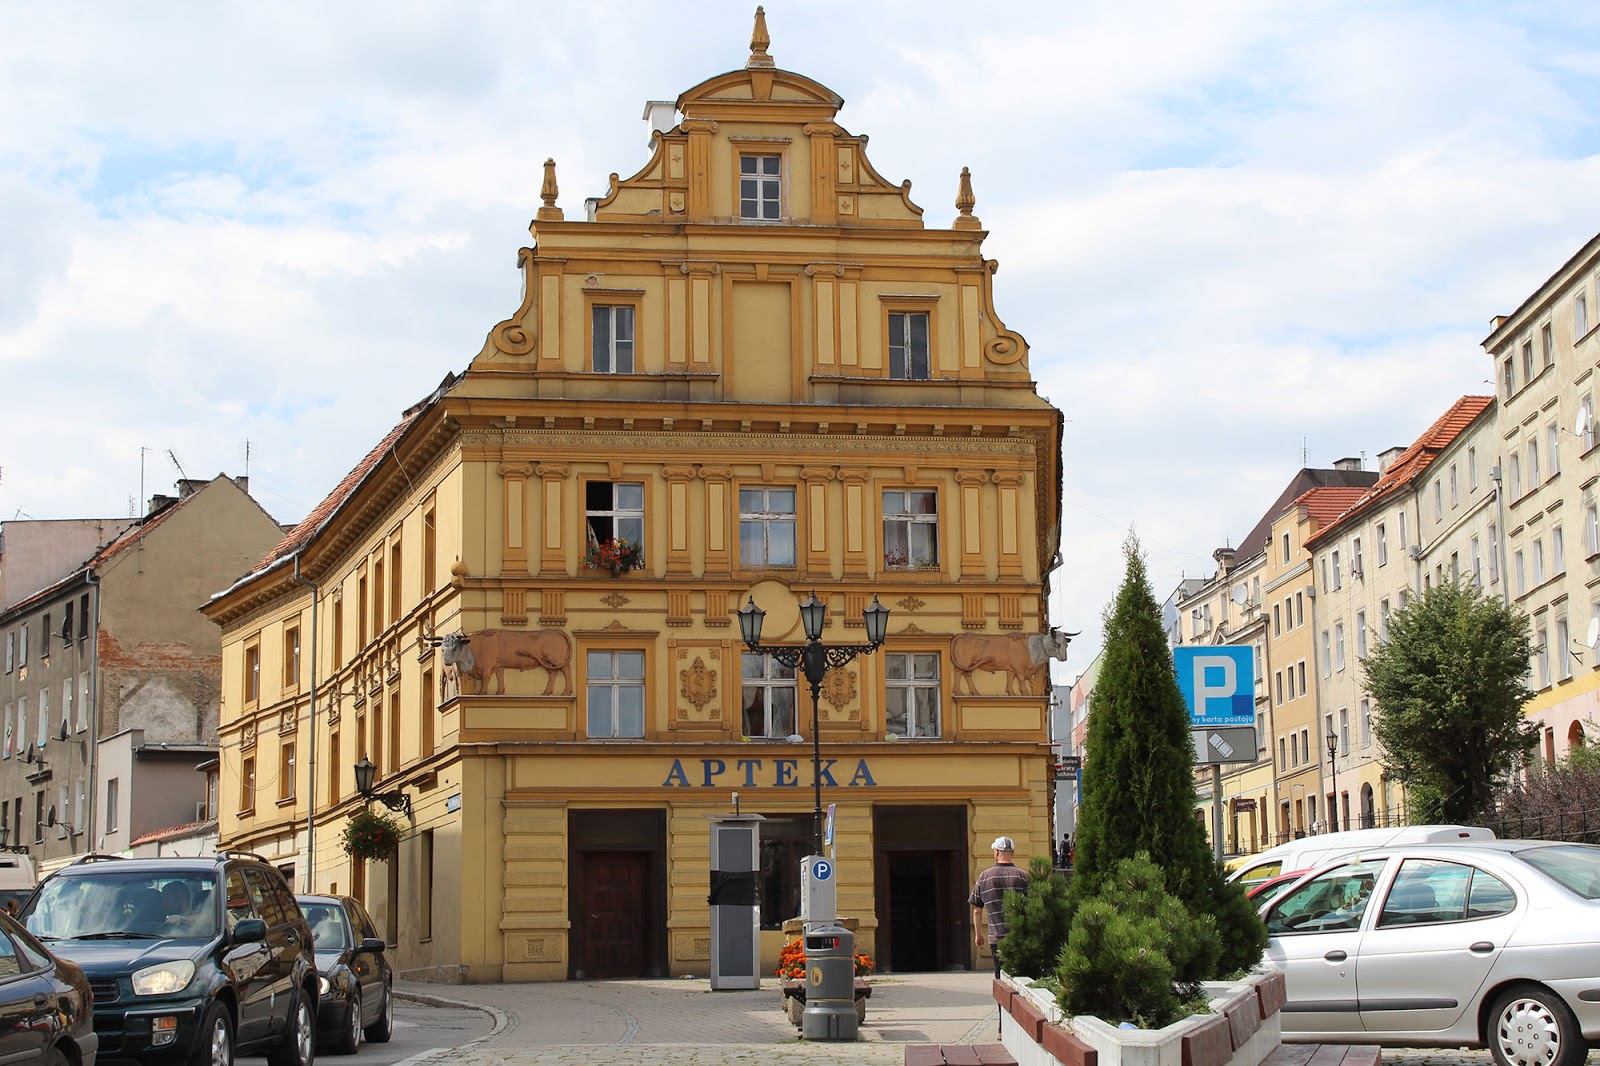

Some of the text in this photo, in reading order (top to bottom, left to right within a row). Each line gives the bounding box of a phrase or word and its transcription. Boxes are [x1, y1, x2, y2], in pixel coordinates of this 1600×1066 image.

[1193, 655, 1237, 716] P
[1224, 715, 1254, 724] postoju
[662, 758, 877, 787] APTEKA
[817, 863, 828, 878] P
